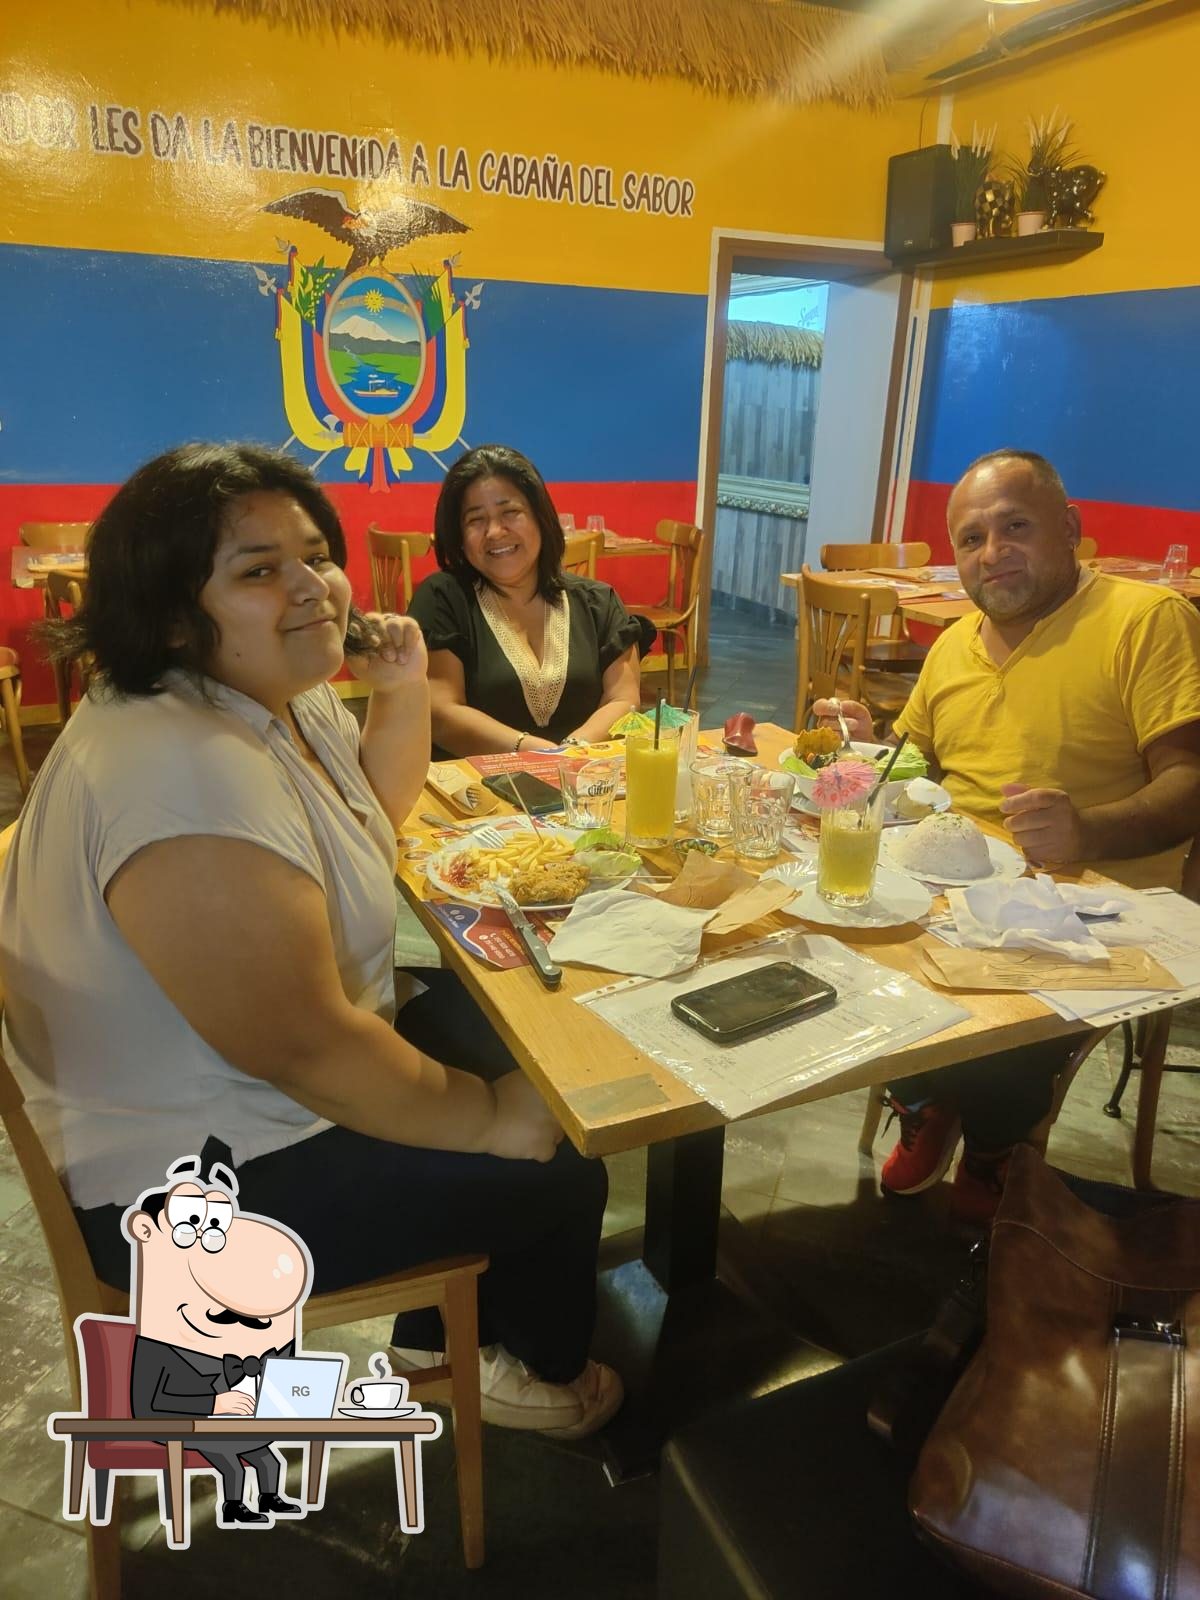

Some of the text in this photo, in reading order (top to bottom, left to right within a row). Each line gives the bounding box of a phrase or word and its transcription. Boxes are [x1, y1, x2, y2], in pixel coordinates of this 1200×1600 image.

[90, 103, 142, 156] LES
[151, 112, 193, 160] DA
[202, 117, 242, 165] LA
[410, 143, 430, 185] A
[438, 147, 470, 190] LA
[479, 152, 574, 203] CABAÑA
[578, 166, 617, 208] DEL
[622, 173, 694, 217] SABOR
